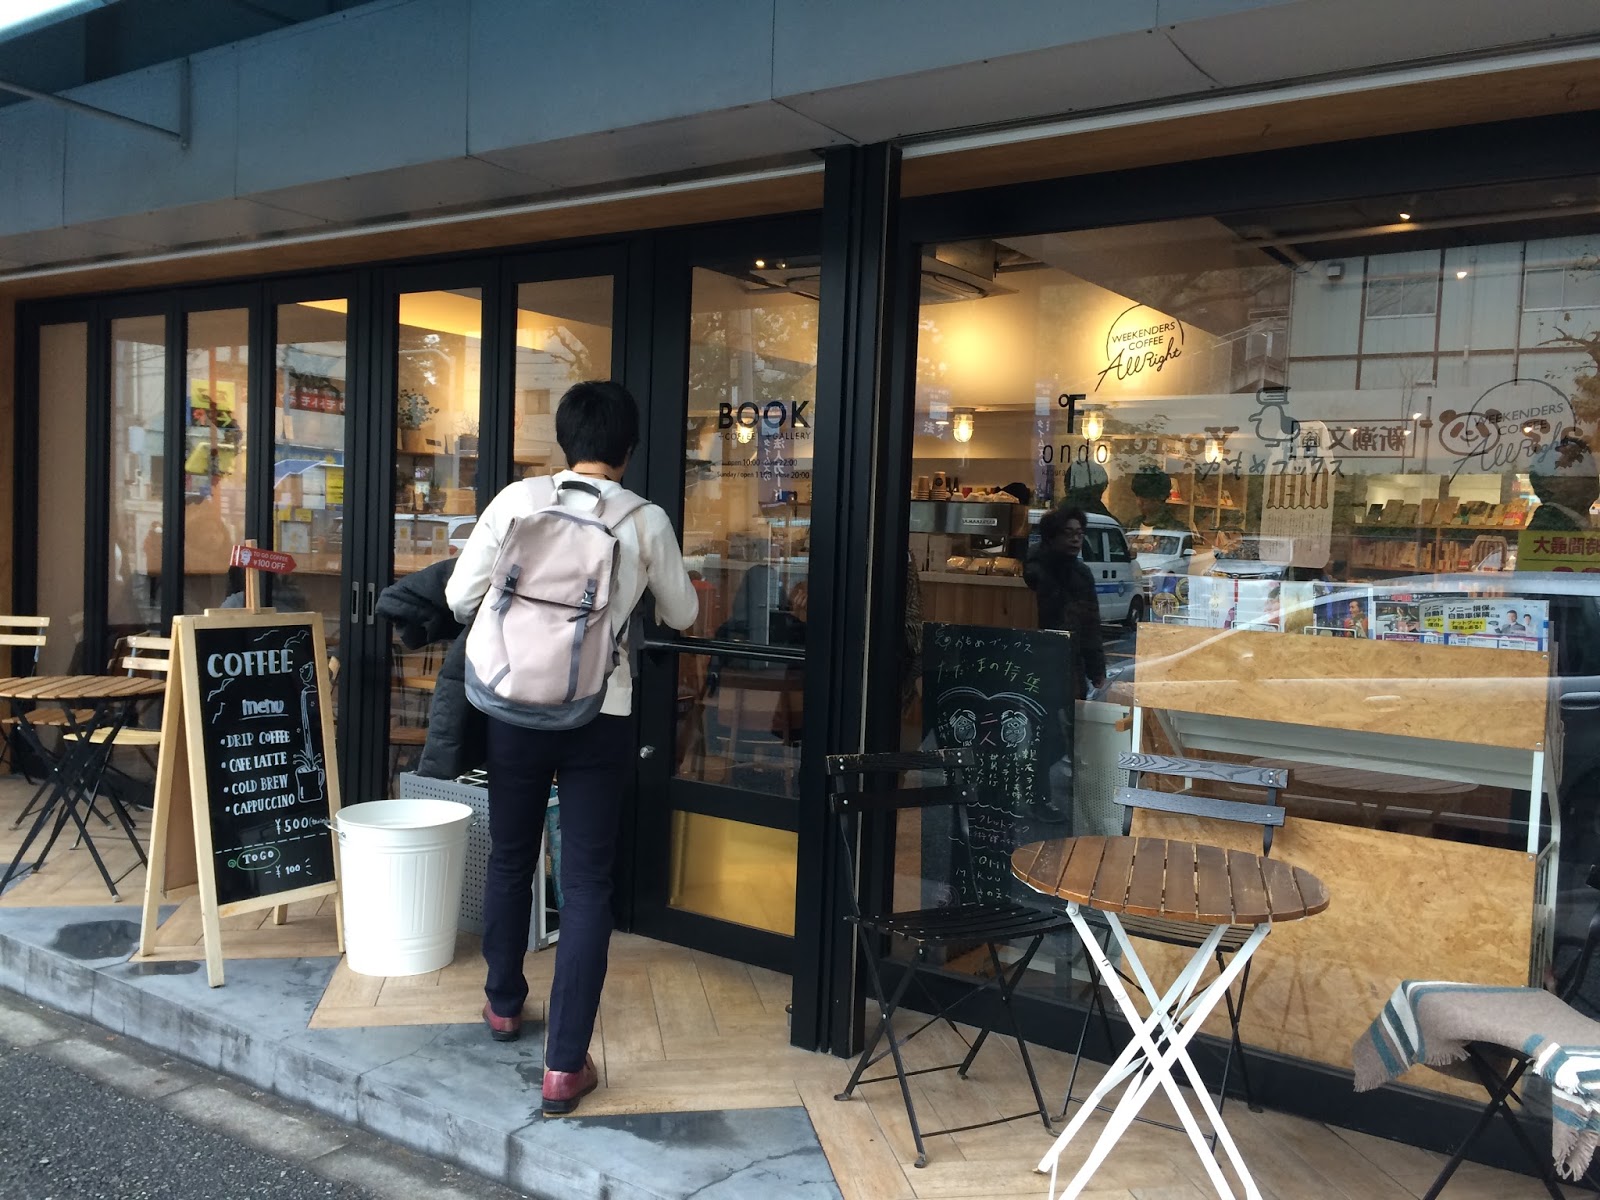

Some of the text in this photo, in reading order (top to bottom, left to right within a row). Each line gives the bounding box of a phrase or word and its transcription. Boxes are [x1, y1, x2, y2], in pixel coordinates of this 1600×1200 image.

[1112, 322, 1176, 343] WEEKENDERS
[1128, 335, 1164, 350] COFFEE
[718, 400, 811, 429] BOOK
[1474, 403, 1564, 425] WEEKENDERS
[1043, 439, 1107, 463] ondo
[790, 471, 809, 479] 20:00
[270, 554, 288, 562] COFFEE
[271, 562, 286, 570] OFF
[207, 649, 294, 678] COFFEE
[242, 699, 284, 716] menu
[226, 732, 254, 748] DRIP
[229, 751, 288, 773] CAFE LATTE
[231, 773, 288, 795] COLD BREW
[233, 793, 295, 815] CAPPUCCINO
